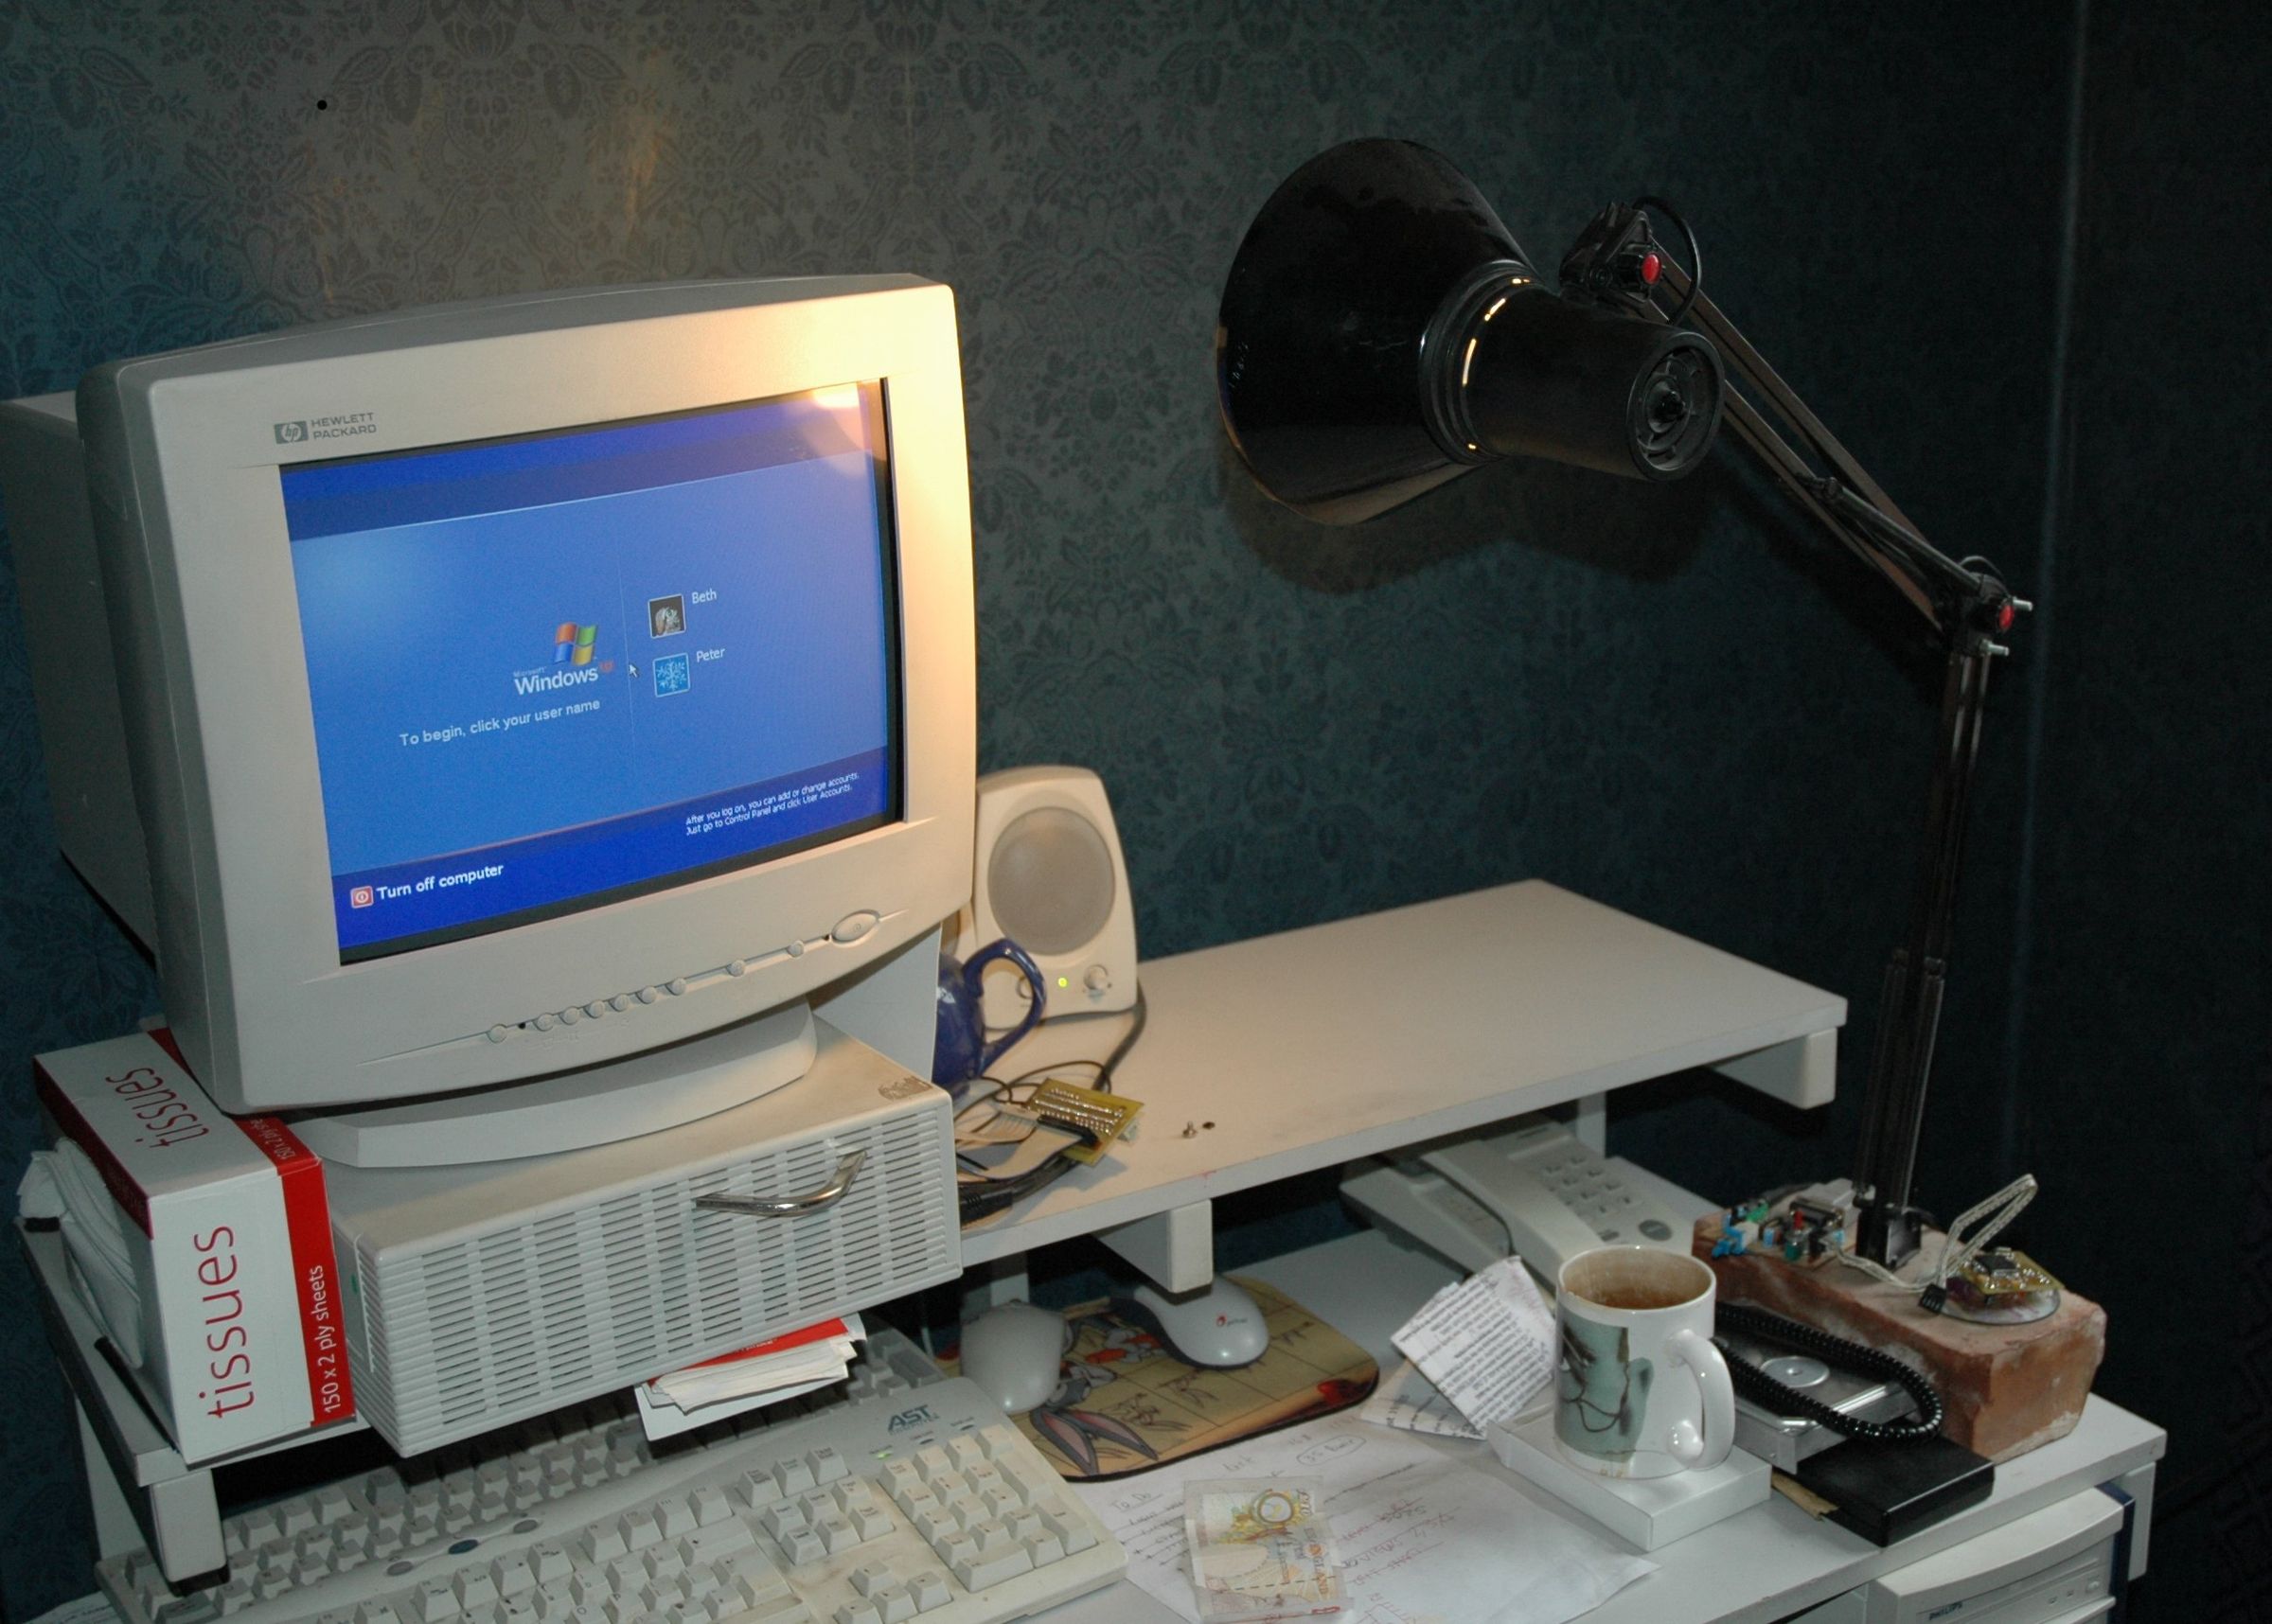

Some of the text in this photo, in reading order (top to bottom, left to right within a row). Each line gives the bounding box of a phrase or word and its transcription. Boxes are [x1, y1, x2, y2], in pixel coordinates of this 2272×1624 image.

[311, 413, 374, 428] HEWLETT
[313, 424, 377, 439] PACKARD
[692, 588, 717, 604] Beth
[697, 648, 725, 662] Peter
[514, 667, 599, 695] Windows
[399, 699, 600, 746] To begin, click your user name
[686, 814, 704, 825] After
[706, 811, 720, 821] you
[721, 806, 733, 816] log
[748, 800, 762, 810] you
[763, 796, 776, 805] can
[778, 790, 790, 801] add
[792, 789, 800, 798] or
[802, 782, 826, 795] change
[686, 825, 701, 836] Just
[703, 822, 713, 833] go
[715, 820, 723, 828] to
[724, 811, 750, 825] Control
[752, 805, 771, 818] Panel
[772, 802, 786, 813] and
[787, 797, 801, 808] click
[803, 794, 818, 804] User
[377, 865, 504, 900] Turn off computer
[105, 1068, 209, 1148] tissues
[194, 1226, 255, 1418] tissues
[308, 1264, 341, 1413] 150 x 2 ply sheets
[888, 1404, 932, 1431] AST
